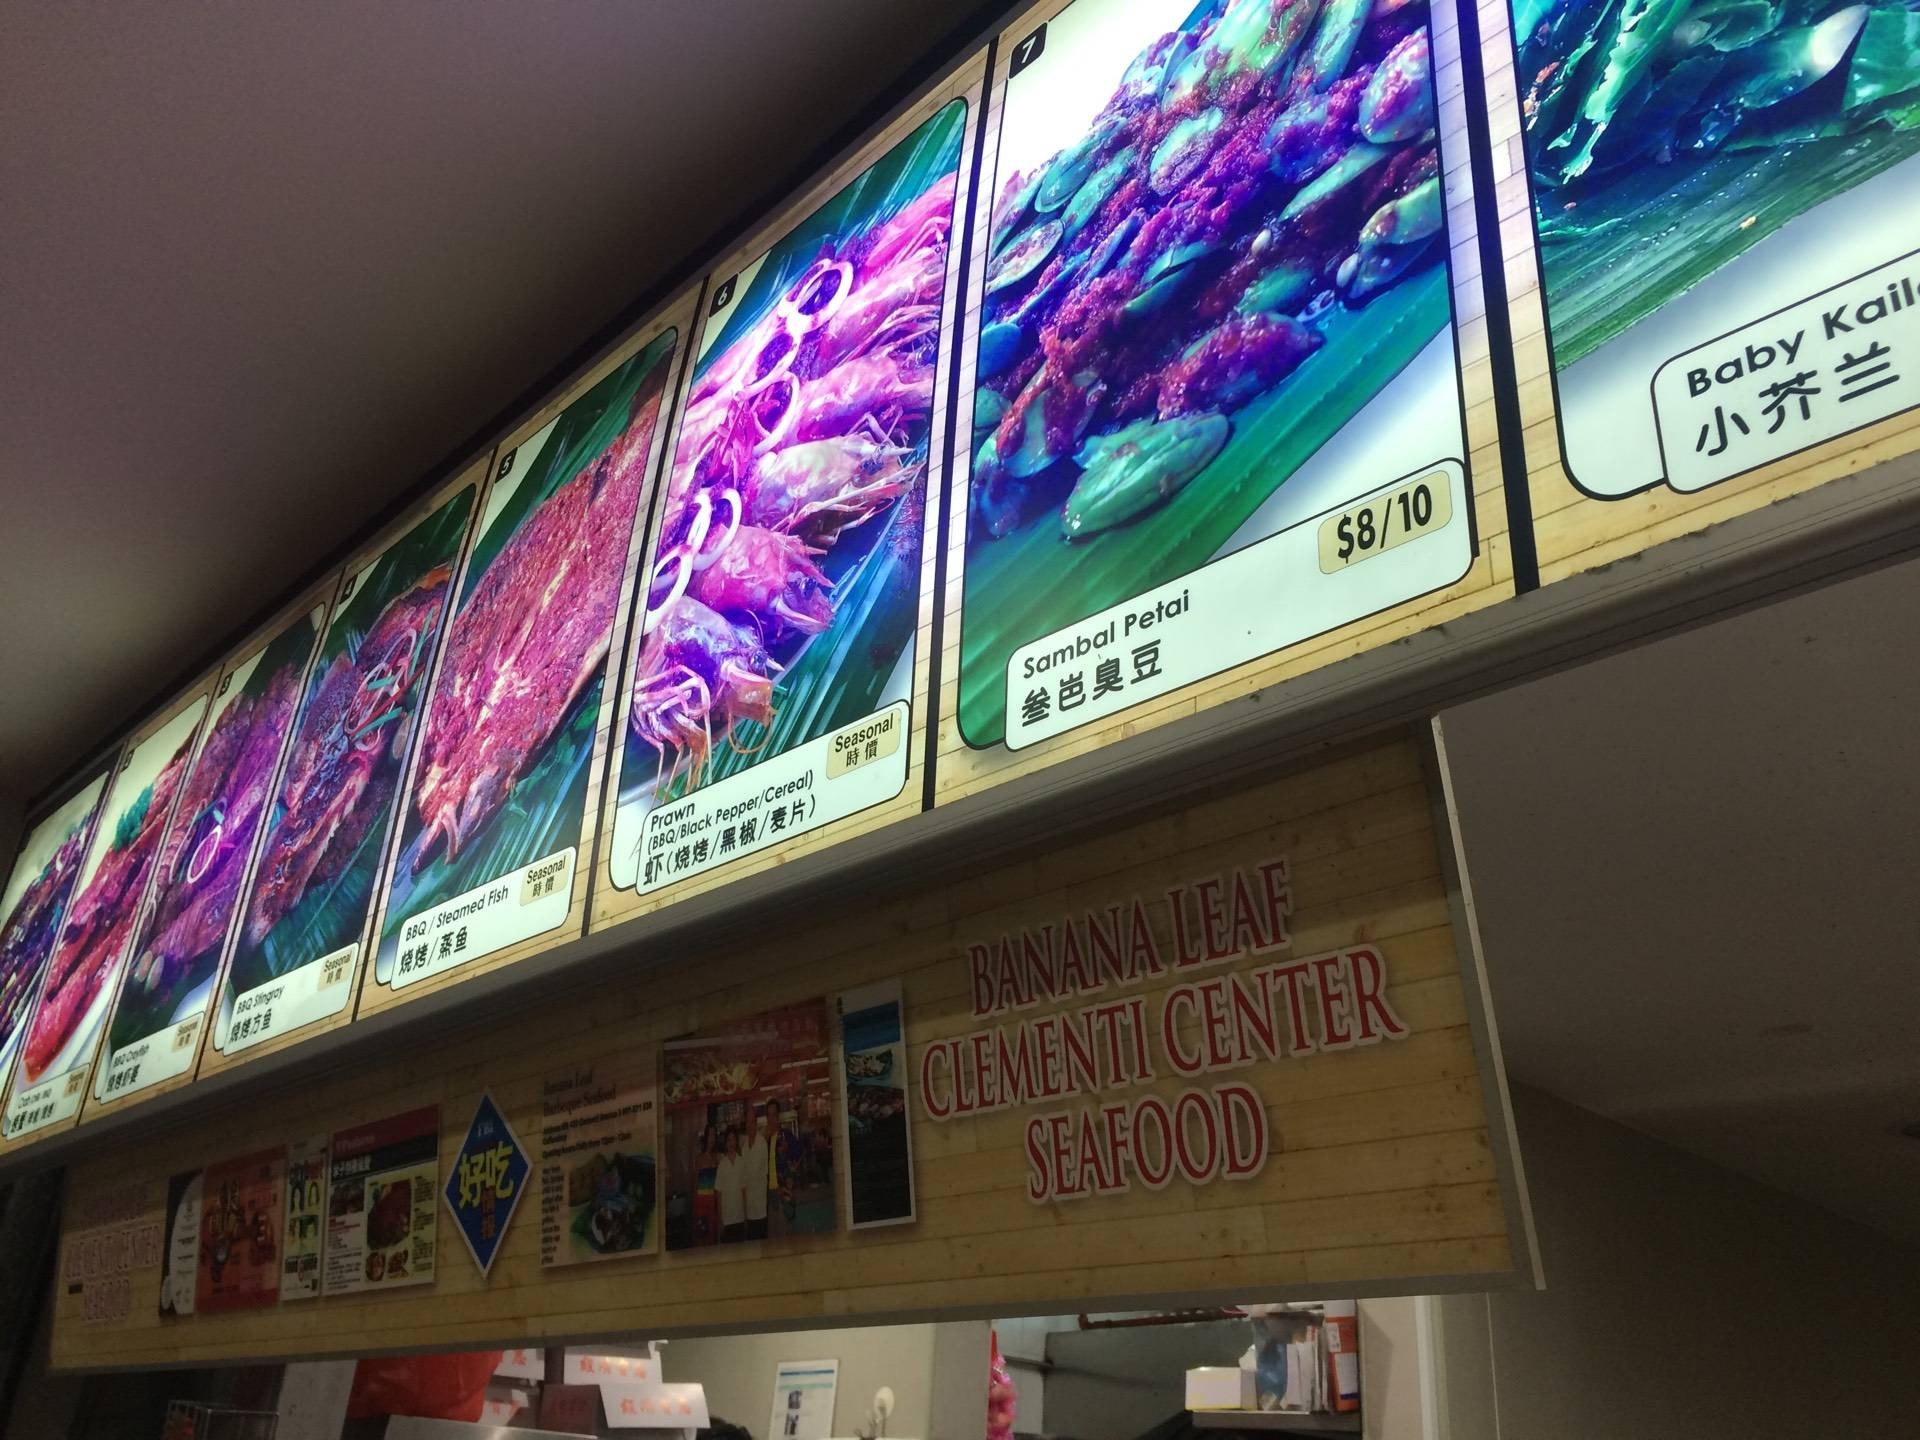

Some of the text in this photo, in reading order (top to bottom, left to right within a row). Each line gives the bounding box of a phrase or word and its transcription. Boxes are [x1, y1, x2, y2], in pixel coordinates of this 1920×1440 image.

[1020, 35, 1038, 64] 7
[1686, 276, 1920, 399] Baby Kail
[1695, 341, 1901, 457] 小芥兰
[1336, 483, 1434, 564] $8/10
[1022, 588, 1191, 680] Sambal Petai
[834, 712, 895, 754] Seasonal
[646, 769, 815, 857] (BBQ/Black Pepper/Cereal)
[650, 801, 697, 833] Prawn
[405, 920, 428, 942] BBQ
[436, 896, 487, 930] Steamed
[487, 884, 510, 908] Fish
[526, 854, 568, 886] Seasonal
[968, 859, 1292, 1017] BANANA LEAF
[920, 949, 1406, 1119] CLEMENTI CENTER
[1025, 1084, 1267, 1201] SEAFOOD
